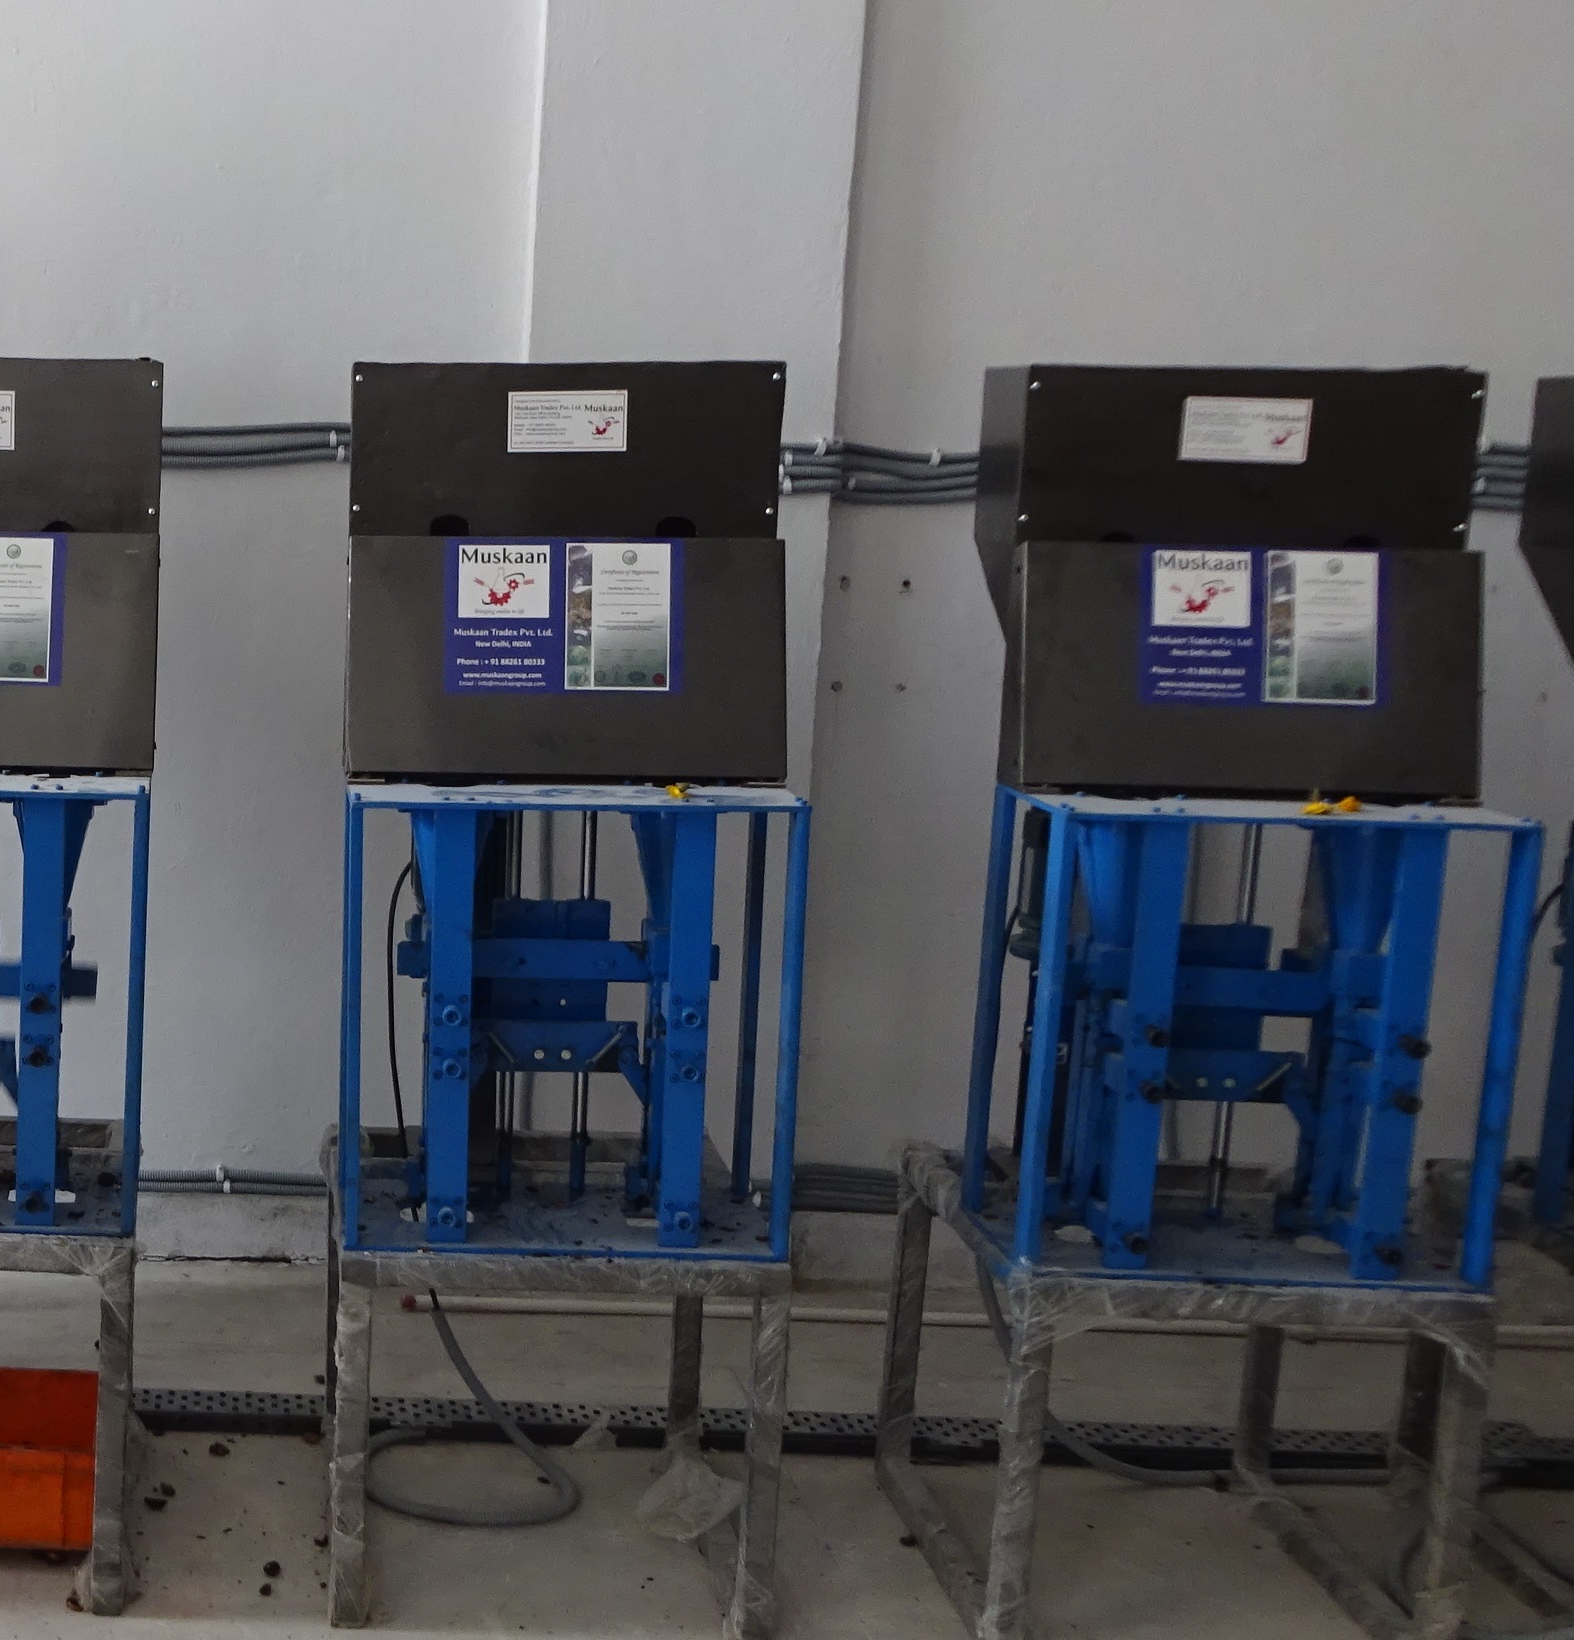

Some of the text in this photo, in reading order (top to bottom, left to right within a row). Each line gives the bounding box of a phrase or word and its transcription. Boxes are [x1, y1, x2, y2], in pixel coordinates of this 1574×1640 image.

[585, 404, 623, 412] Muskaan
[461, 547, 547, 564] Muskaan
[1158, 553, 1248, 571] Muskaan
[454, 628, 489, 636] Muskaan
[490, 628, 518, 636] Tradex
[519, 628, 535, 636] Pvt.
[492, 640, 511, 648] Delhi,
